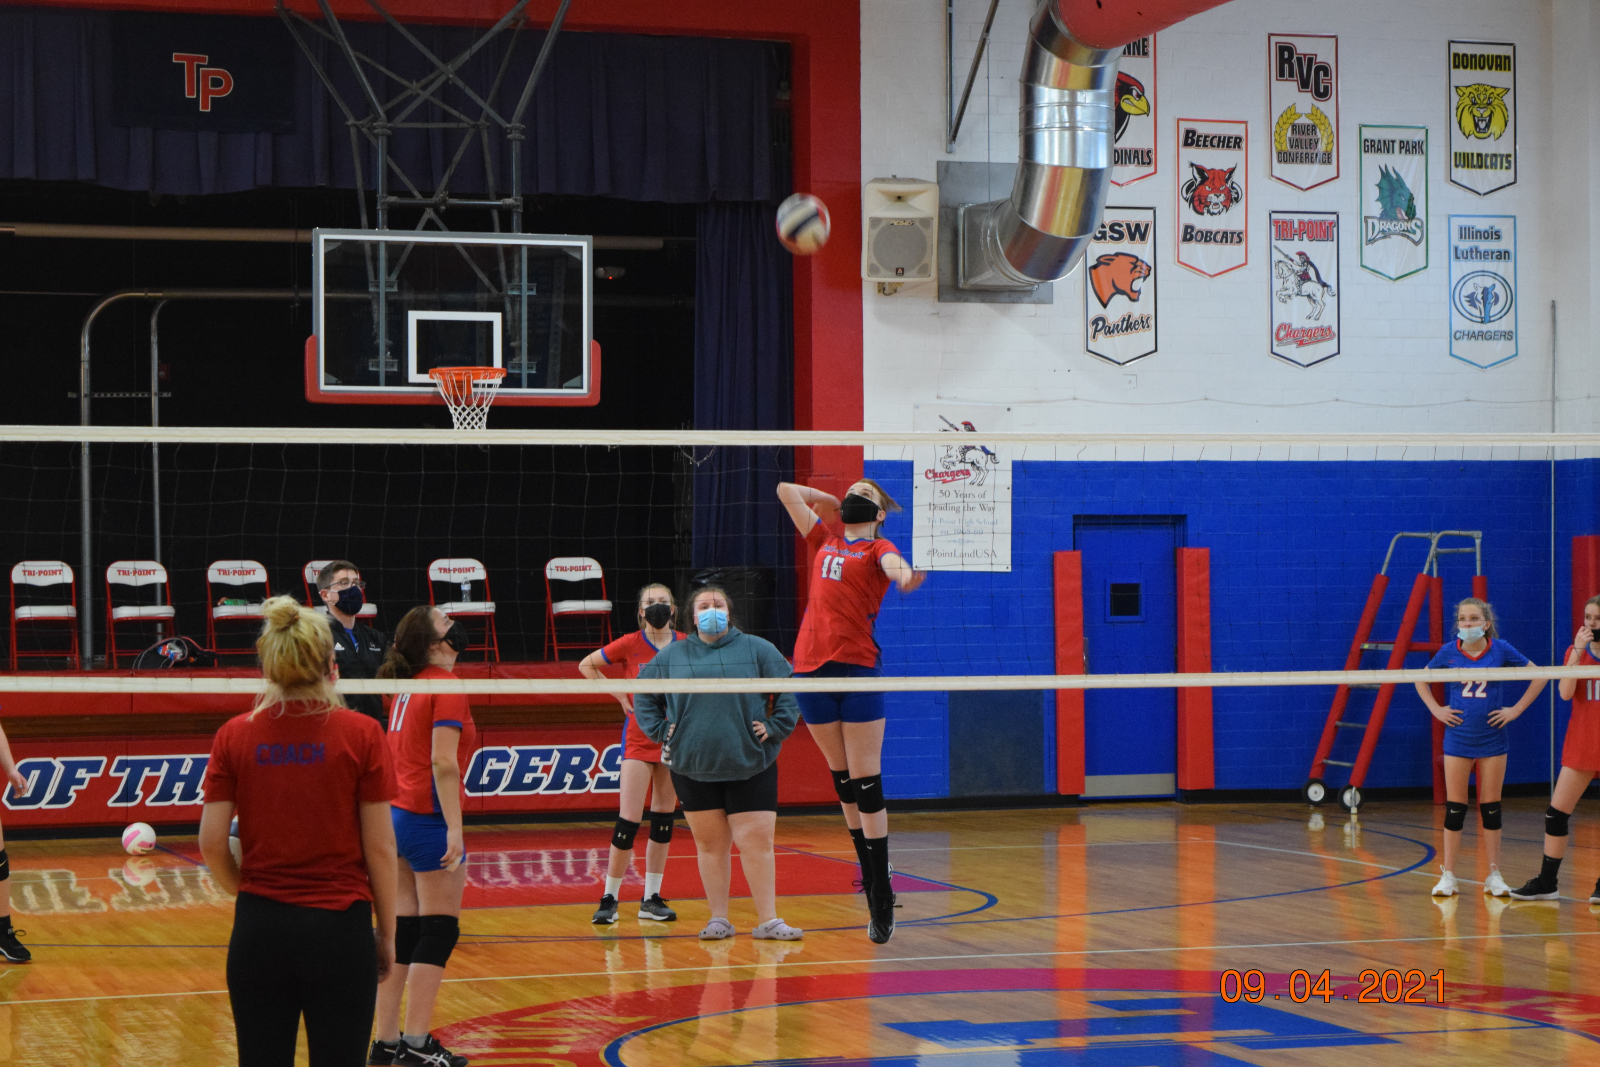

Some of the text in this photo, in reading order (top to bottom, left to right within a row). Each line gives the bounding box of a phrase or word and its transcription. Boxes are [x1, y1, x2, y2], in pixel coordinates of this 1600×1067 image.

[1452, 53, 1512, 72] DONOVAN
[1275, 42, 1332, 102] RVC
[173, 53, 233, 112] TP
[1291, 124, 1318, 136] RIVER
[1183, 129, 1243, 149] BEECHER
[1288, 137, 1320, 150] VALLEY
[1363, 138, 1424, 155] GRANT PARK
[1277, 151, 1333, 164] CONFERENCE
[1453, 152, 1512, 170] WILDCATS
[1093, 221, 1150, 242] GSW
[1182, 224, 1244, 244] BOBCATS
[1273, 219, 1336, 241] TRI-POINT
[1364, 216, 1424, 246] DRAGONS
[1458, 225, 1501, 241] Illinois
[1453, 246, 1511, 261] Lutheran
[1091, 313, 1151, 340] Panthers
[1275, 322, 1335, 344] Chargers
[1453, 330, 1513, 342] CHARGERS
[925, 468, 971, 483] Chargers
[939, 489, 987, 499] 50 Years of
[928, 502, 996, 515] Leading the Way
[976, 518, 998, 526] School
[22, 569, 63, 577] TRI-POINT
[117, 569, 157, 577] TRI-POINT
[217, 569, 257, 577] TRI-POINT
[438, 566, 476, 574] TRI-POINT
[555, 565, 592, 573] TRI-POINT
[821, 554, 845, 581] 16
[1461, 680, 1488, 698] 22
[256, 742, 325, 766] COACH
[2, 756, 107, 810] OF
